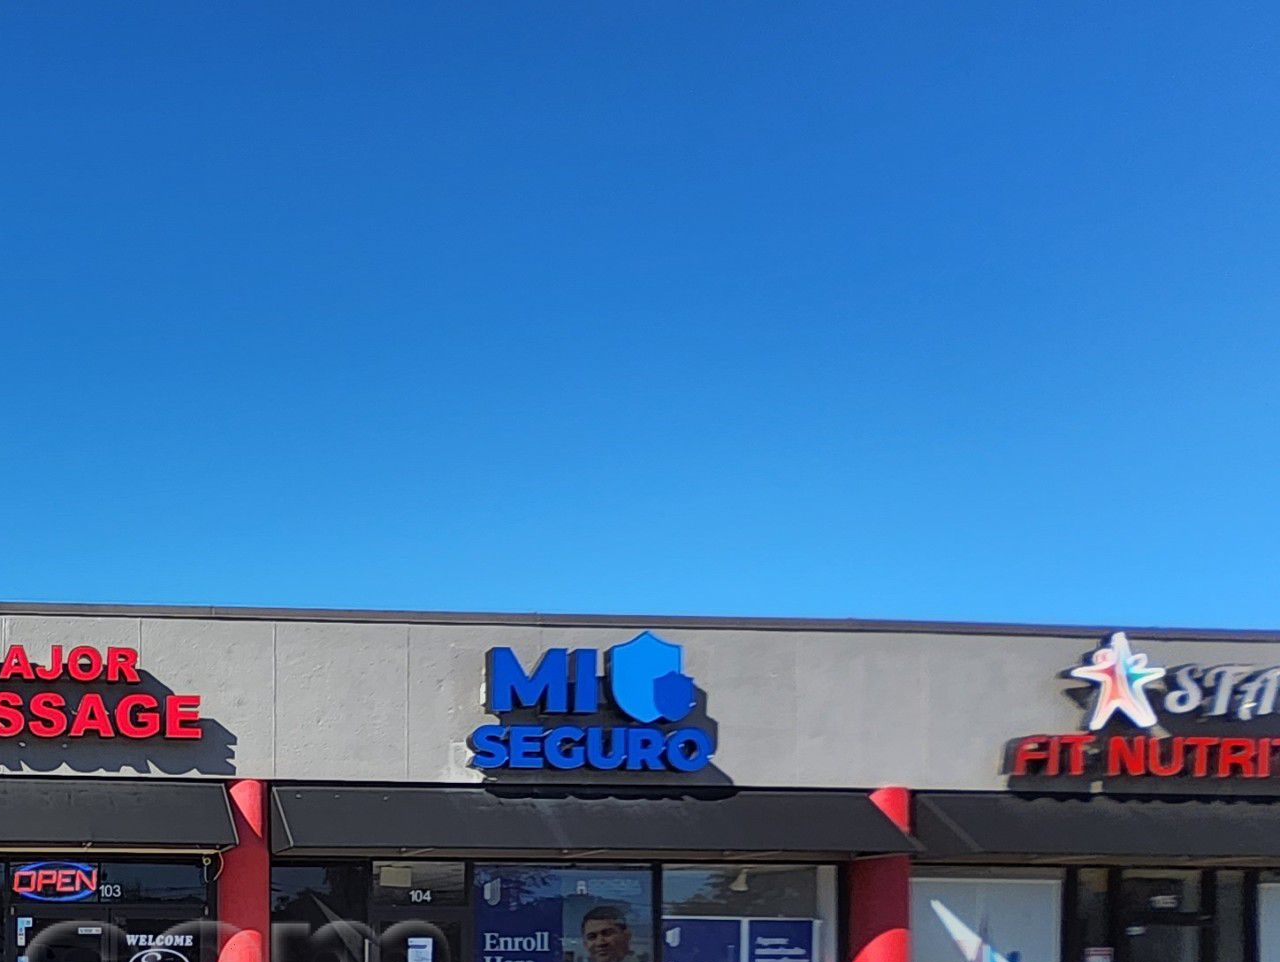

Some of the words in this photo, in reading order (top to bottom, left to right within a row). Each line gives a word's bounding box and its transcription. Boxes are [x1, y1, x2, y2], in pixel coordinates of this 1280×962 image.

[491, 646, 598, 714] MI
[471, 724, 713, 772] SEGURO
[12, 868, 98, 894] OPEN
[98, 885, 122, 898] 103
[409, 889, 432, 902] 104
[126, 934, 194, 947] WELCOME
[483, 931, 551, 952] Enroll
